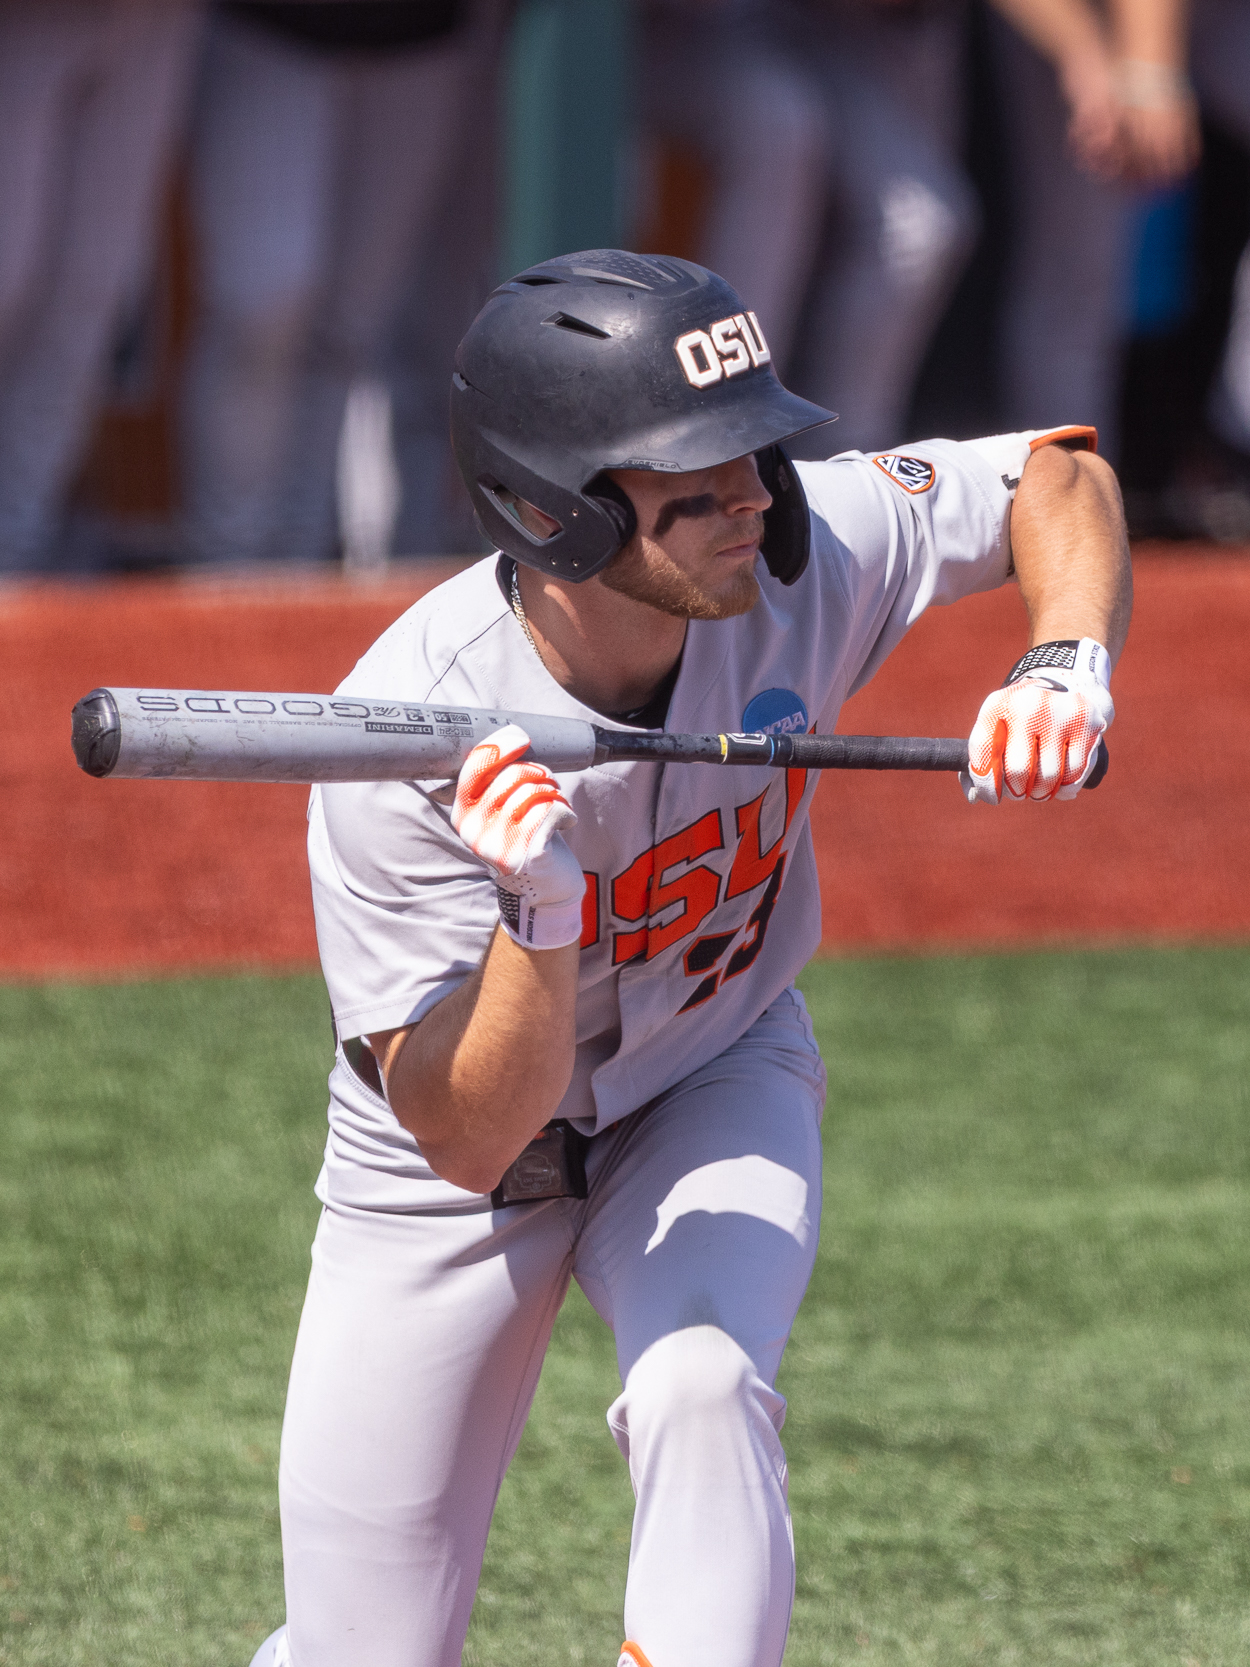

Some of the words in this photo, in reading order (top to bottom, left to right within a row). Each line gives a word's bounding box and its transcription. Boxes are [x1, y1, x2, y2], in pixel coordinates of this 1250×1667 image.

[674, 310, 771, 390] OSU
[627, 460, 677, 469] EVOSHIELD
[136, 696, 371, 719] GOODS
[372, 706, 401, 718] The
[367, 724, 431, 733] DEMARINI
[578, 720, 819, 968] SU
